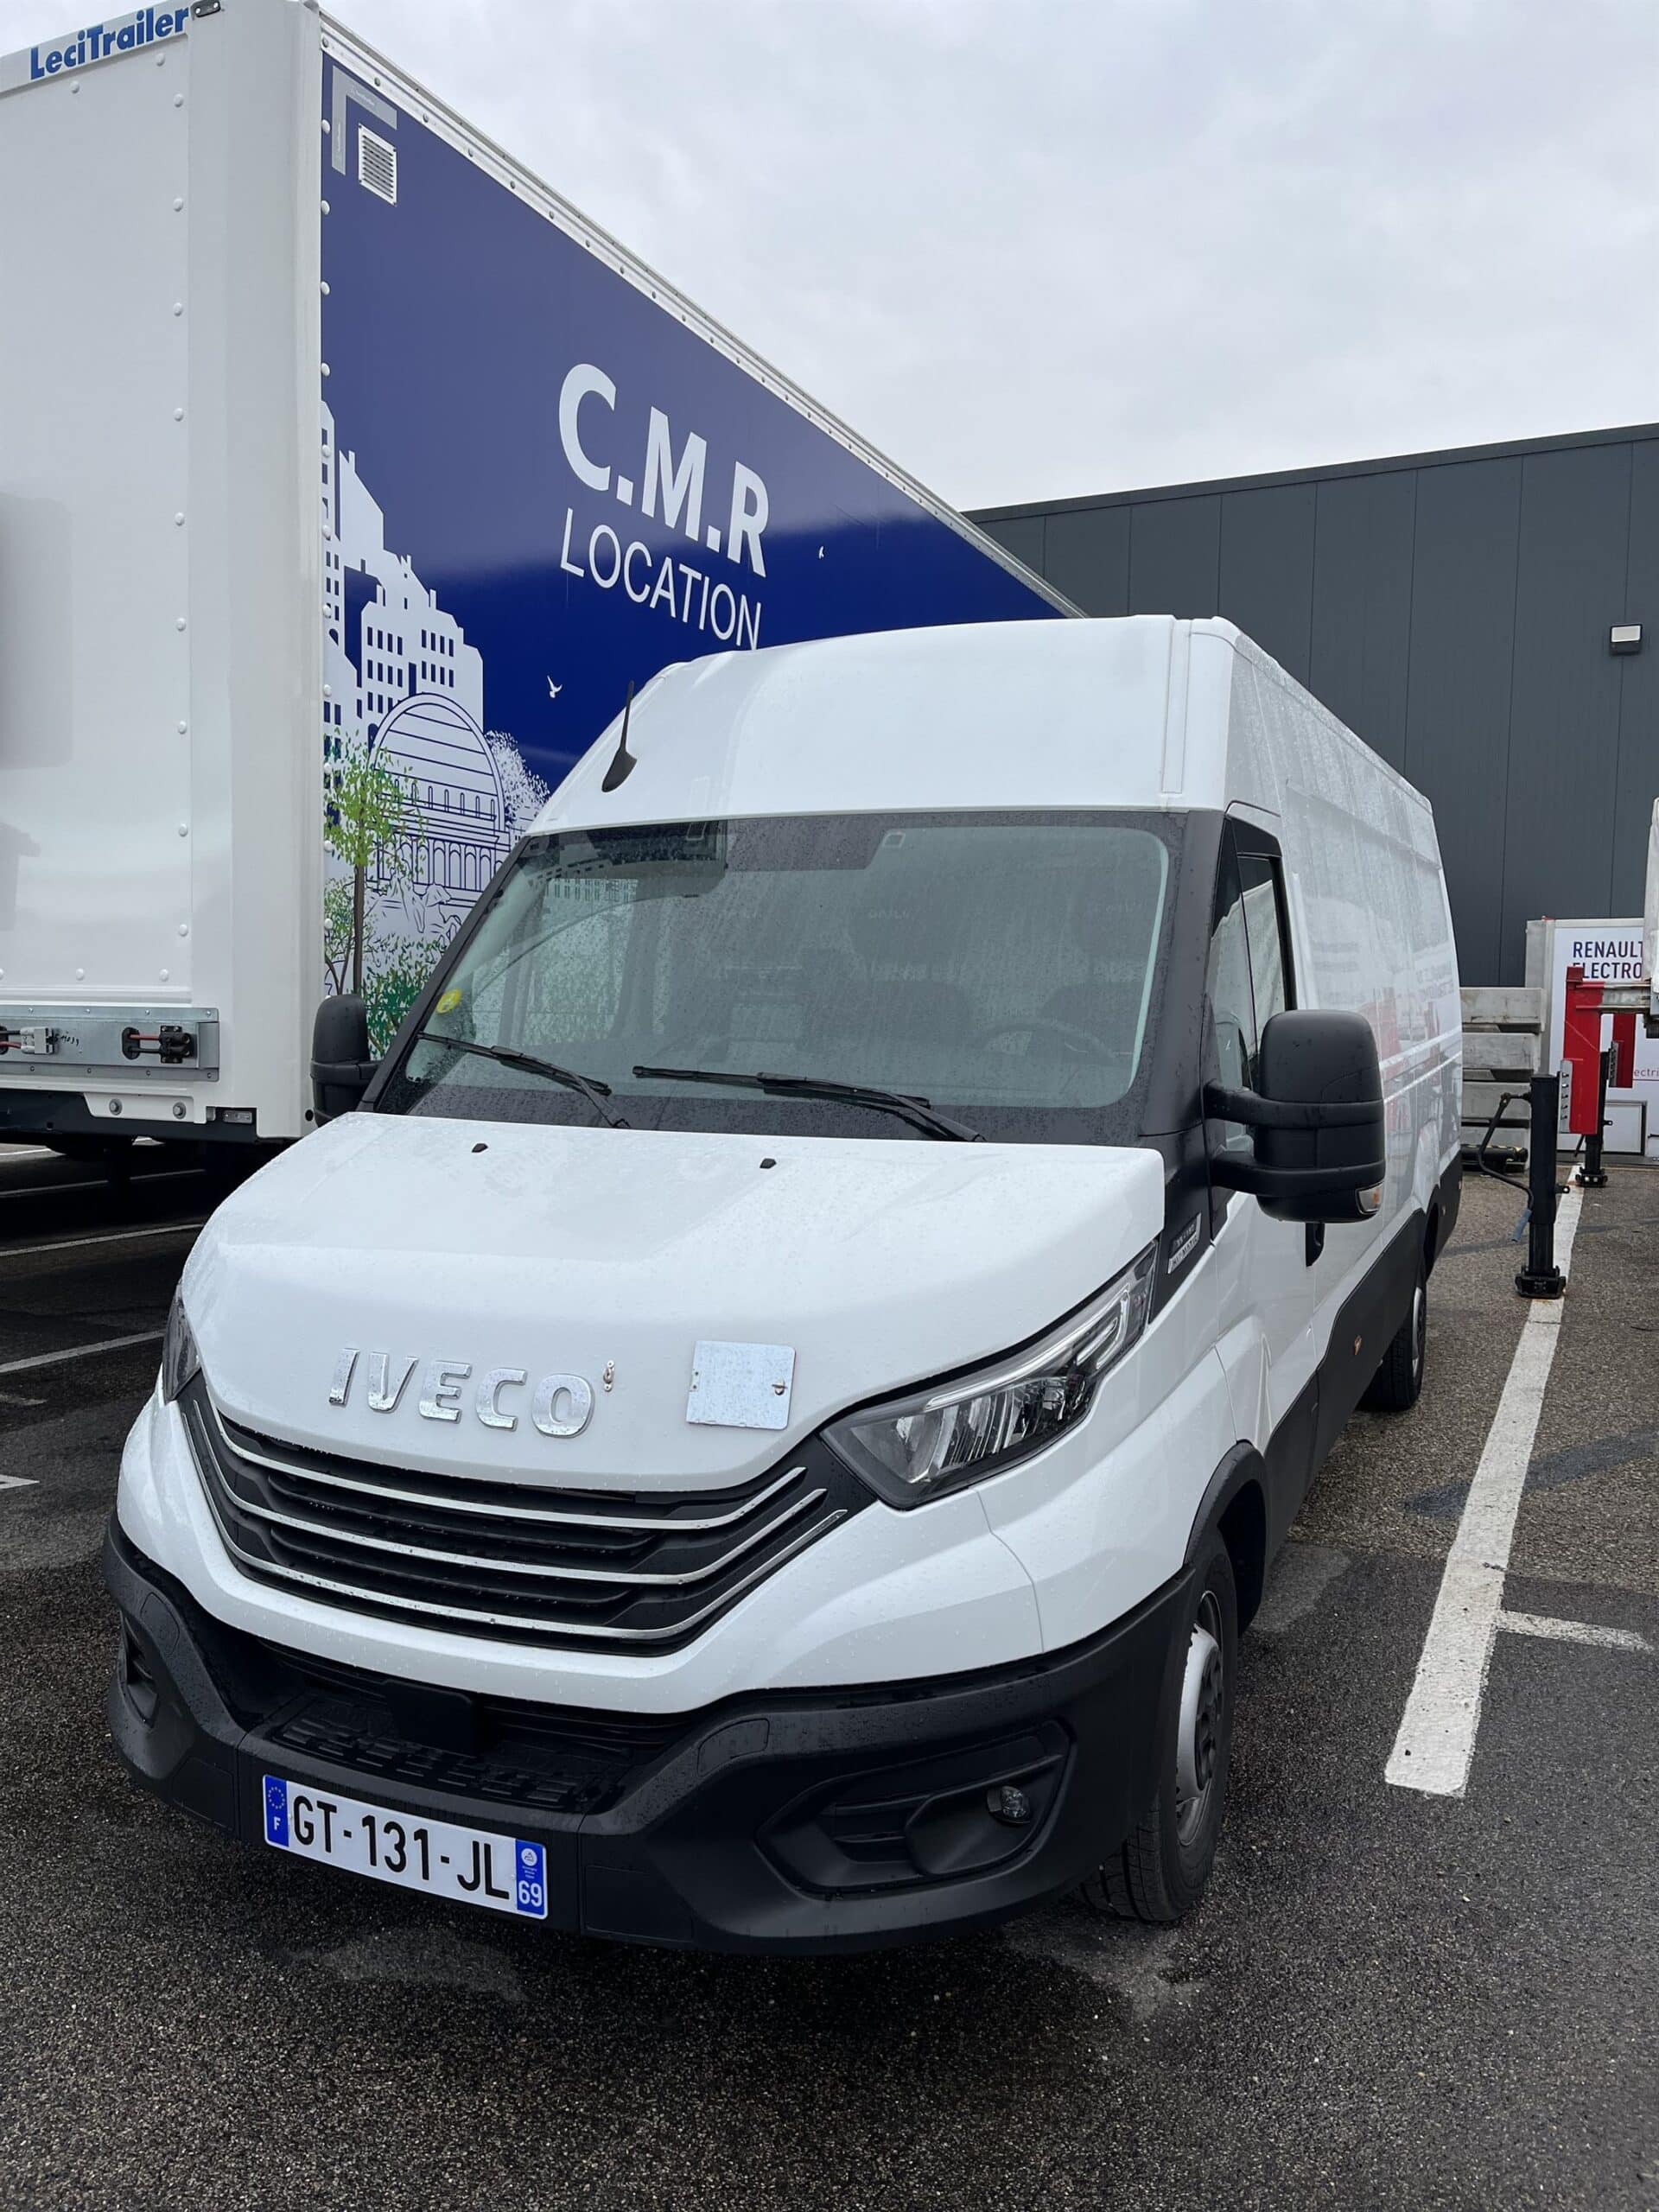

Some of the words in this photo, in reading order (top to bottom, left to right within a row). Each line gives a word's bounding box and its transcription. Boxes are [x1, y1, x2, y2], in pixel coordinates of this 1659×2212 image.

[30, 7, 188, 80] LeciTrailer
[559, 363, 769, 578] C.M.R
[561, 507, 761, 651] LOCATION
[1573, 940, 1643, 958] RENAULT
[1573, 962, 1643, 979] LECTRO
[328, 1348, 595, 1439] IVECO
[273, 1816, 282, 1831] F
[293, 1796, 510, 1900] GT-131-JL
[518, 1879, 543, 1908] 69
